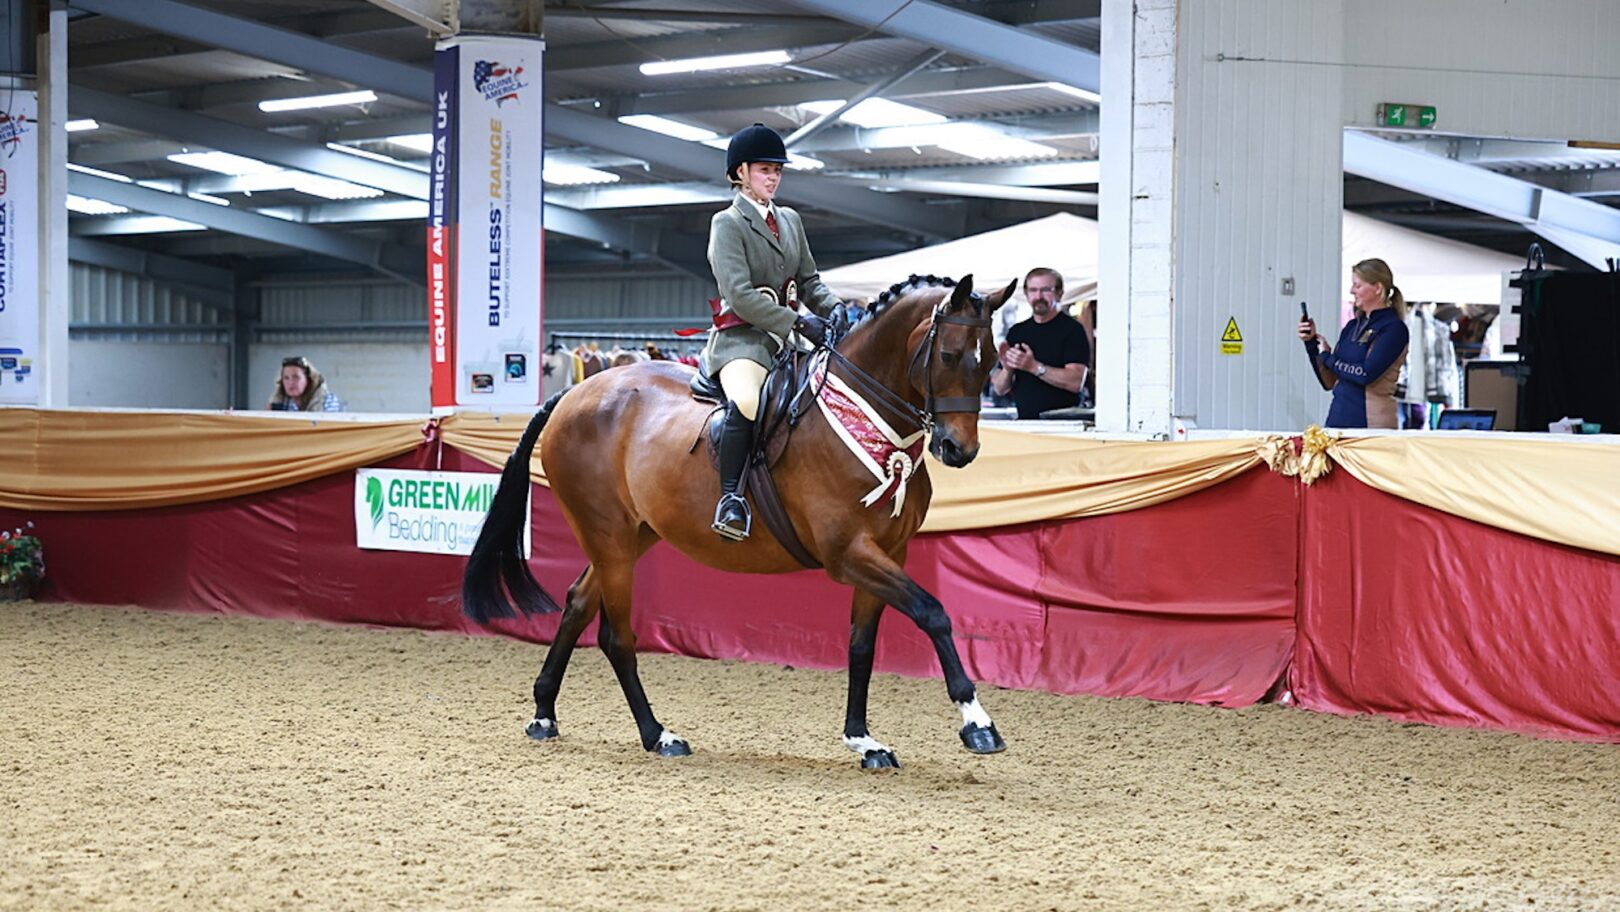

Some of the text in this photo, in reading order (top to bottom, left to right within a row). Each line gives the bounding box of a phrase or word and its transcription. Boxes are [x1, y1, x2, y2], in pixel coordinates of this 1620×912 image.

[485, 82, 523, 100] AMERICA
[490, 118, 502, 199] RANGE
[433, 91, 448, 363] EQUINE AMERICA UK
[388, 511, 457, 550] Bedding
